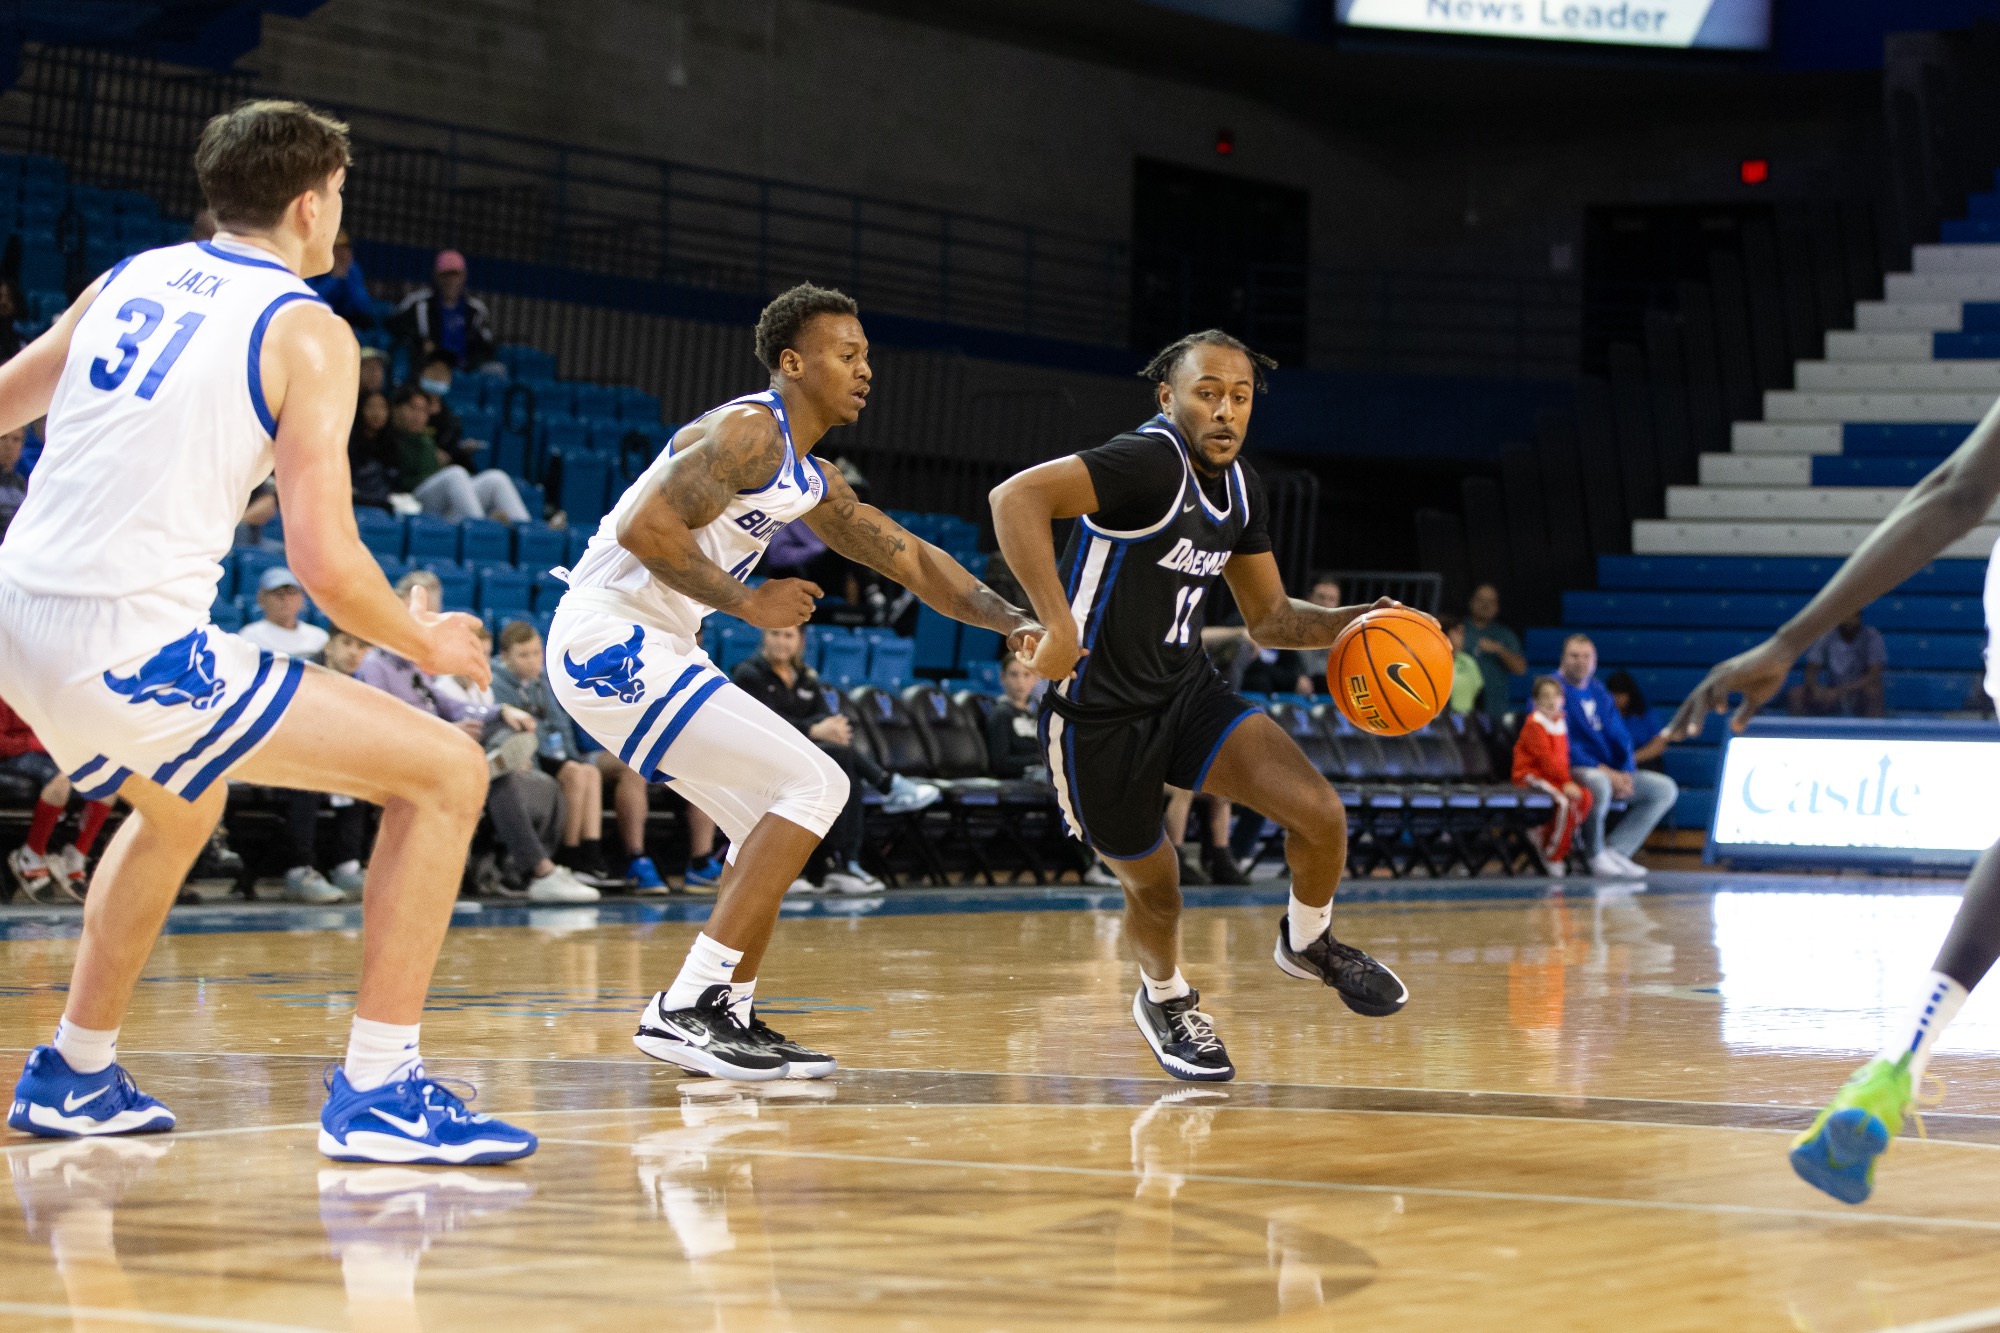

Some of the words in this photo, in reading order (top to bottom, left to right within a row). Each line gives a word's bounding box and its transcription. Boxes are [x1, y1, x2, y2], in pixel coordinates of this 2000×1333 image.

[1424, 0, 1524, 23] News
[1540, 2, 1667, 32] Leader
[166, 268, 230, 298] JACK
[90, 298, 206, 401] 31
[1163, 586, 1204, 646] 11
[1742, 754, 1921, 817] Castle
